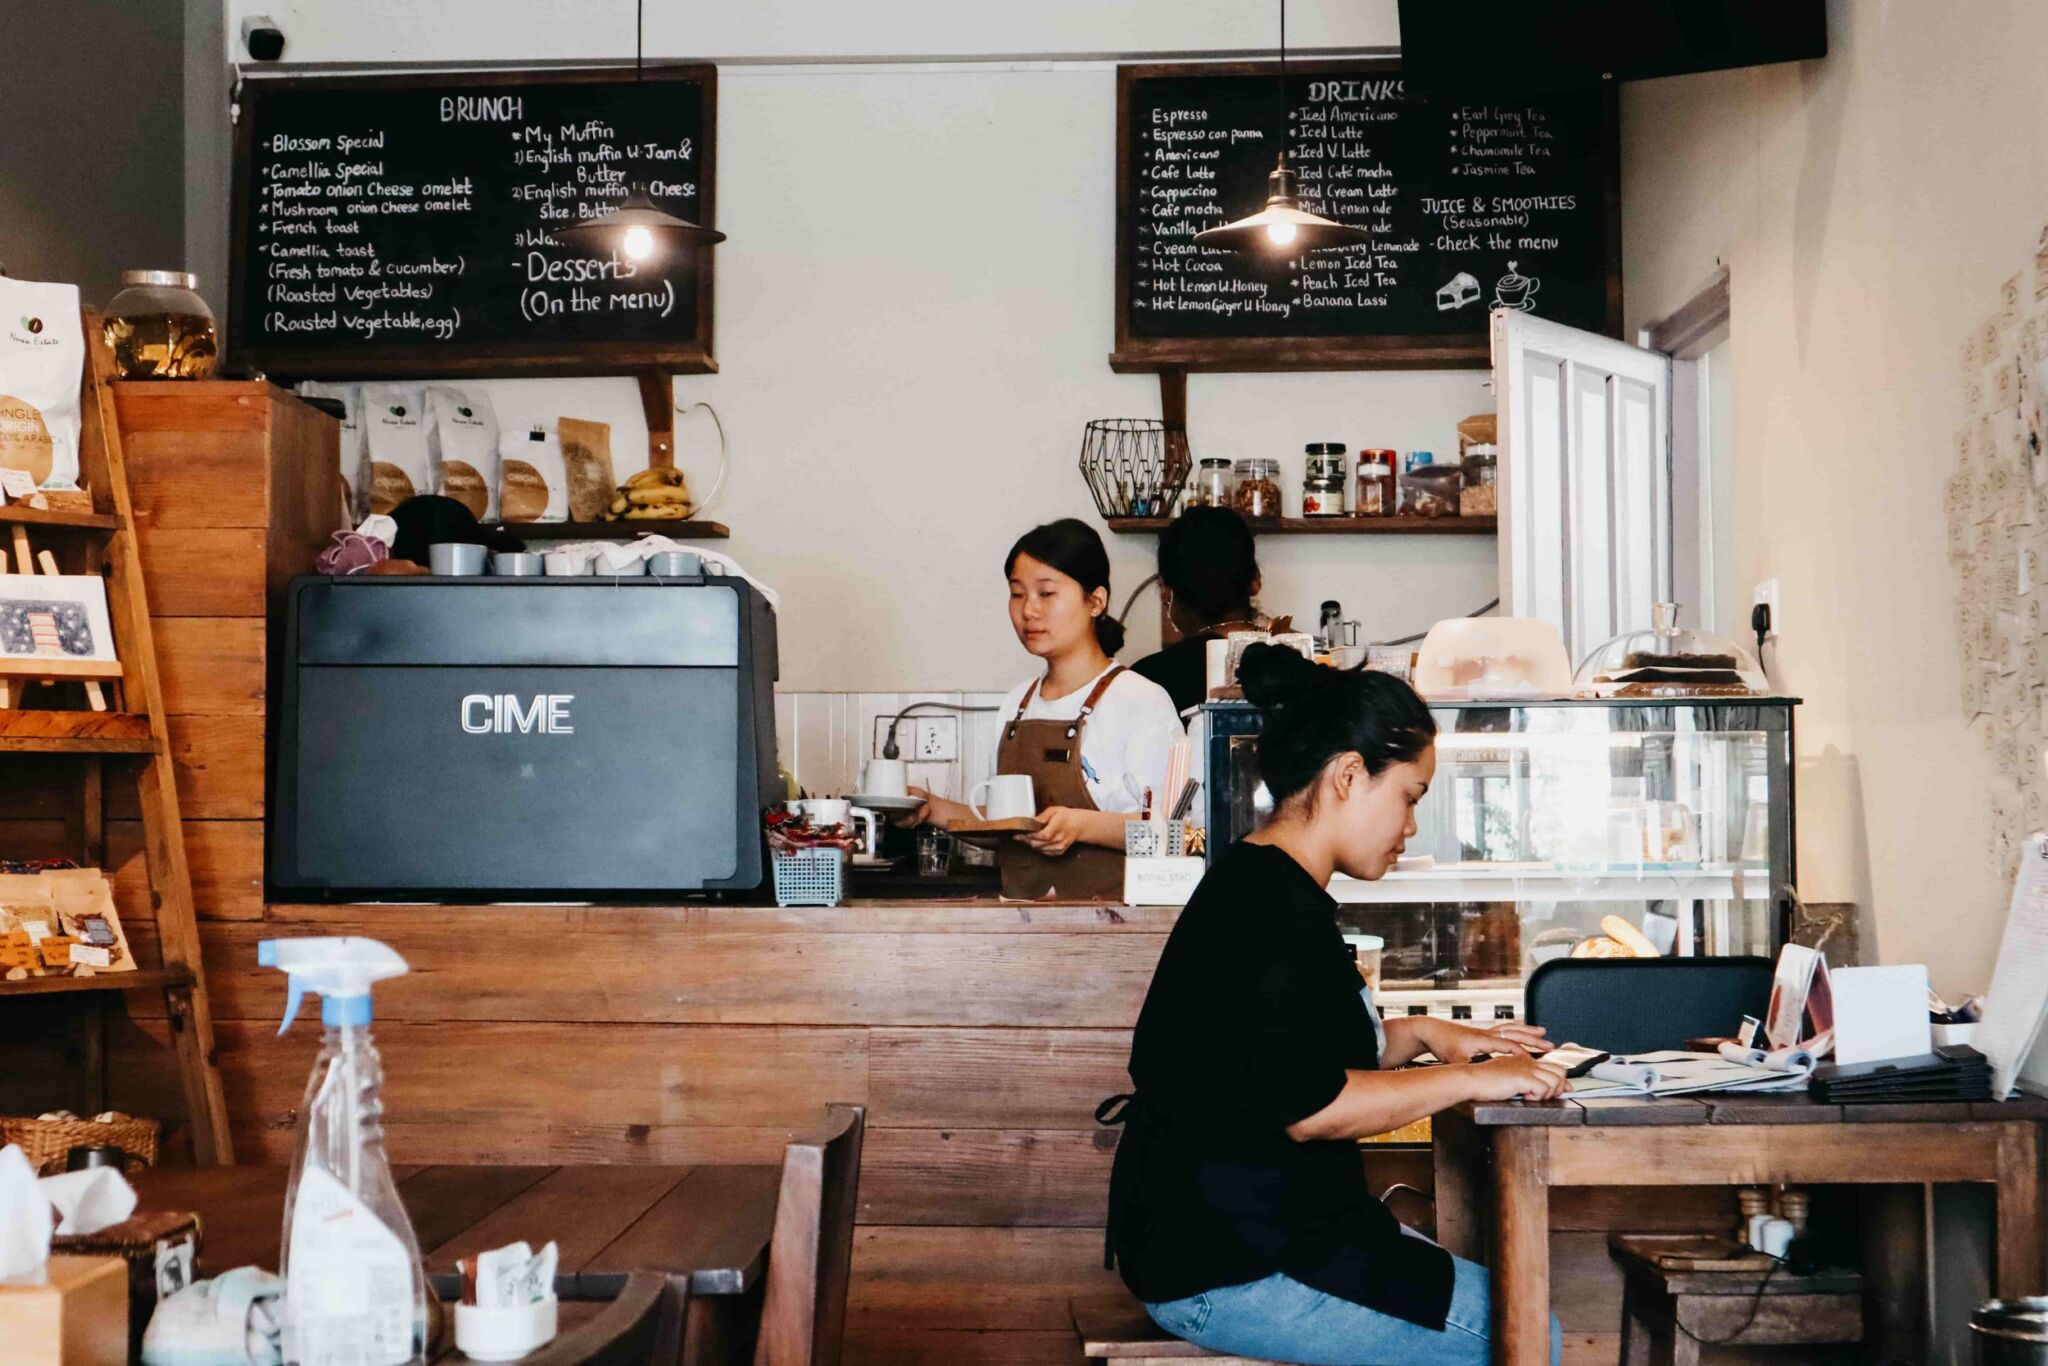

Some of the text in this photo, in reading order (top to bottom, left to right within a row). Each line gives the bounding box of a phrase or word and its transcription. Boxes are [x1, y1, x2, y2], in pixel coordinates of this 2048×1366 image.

[440, 96, 522, 122] BRUNCH
[1298, 105, 1398, 122] Iced Americano
[1462, 106, 1488, 121] Earl
[1525, 107, 1546, 121] Tea
[1152, 108, 1208, 128] Espresso
[525, 120, 614, 153] My Muffin
[1153, 128, 1264, 149] Espresso con panna
[1299, 124, 1363, 139] Iced Latte
[1533, 125, 1553, 139] Tea
[273, 129, 384, 155] Blossom Special
[578, 144, 622, 163] muffin
[678, 138, 692, 160] &
[1297, 142, 1324, 159] Iced
[1527, 143, 1551, 156] Tea
[1155, 148, 1220, 162] Americano
[271, 161, 383, 185] Camellia Special
[577, 164, 626, 183] Butter
[1151, 164, 1180, 179] Cafe
[1297, 164, 1323, 180] Iced
[1462, 161, 1536, 176] Jasmine Tea
[271, 177, 473, 198] Tomato onion Cheese omelet
[585, 182, 629, 197] muffin
[649, 180, 696, 196] Cheese
[1151, 183, 1218, 203] Cappuccino
[1296, 183, 1399, 198] Iced Cream Latte
[272, 198, 472, 217] Mushroom onion Cheese omelet
[1152, 201, 1224, 217] Cafe mocha
[1298, 199, 1329, 214] Mint
[1421, 195, 1576, 214] JUICE & SMOOTHIES
[272, 219, 360, 234] French toast
[1151, 219, 1197, 236] Vanilla
[1443, 213, 1530, 230] (Seasonable)
[271, 242, 376, 257] Camellia toast
[1153, 241, 1197, 255] Cream
[1487, 233, 1512, 250] the
[1518, 236, 1559, 249] menu
[268, 255, 465, 280] (Fresh tomato & cucumber)
[527, 250, 637, 282] Desserts
[1152, 257, 1223, 272] Hot Cocoa
[1300, 254, 1398, 270] Lemon Iced Tea
[1152, 276, 1176, 292] Hot
[1302, 272, 1397, 290] Peach Iced Tea
[267, 282, 336, 303] (Roasted
[521, 279, 674, 321] (On the menu)
[1303, 292, 1387, 308] Banana Lassi
[1152, 295, 1176, 311] Hot
[1255, 299, 1290, 318] Honey
[264, 310, 337, 332] (Roasted
[0, 408, 41, 420] INGLE
[461, 694, 575, 734] CIME
